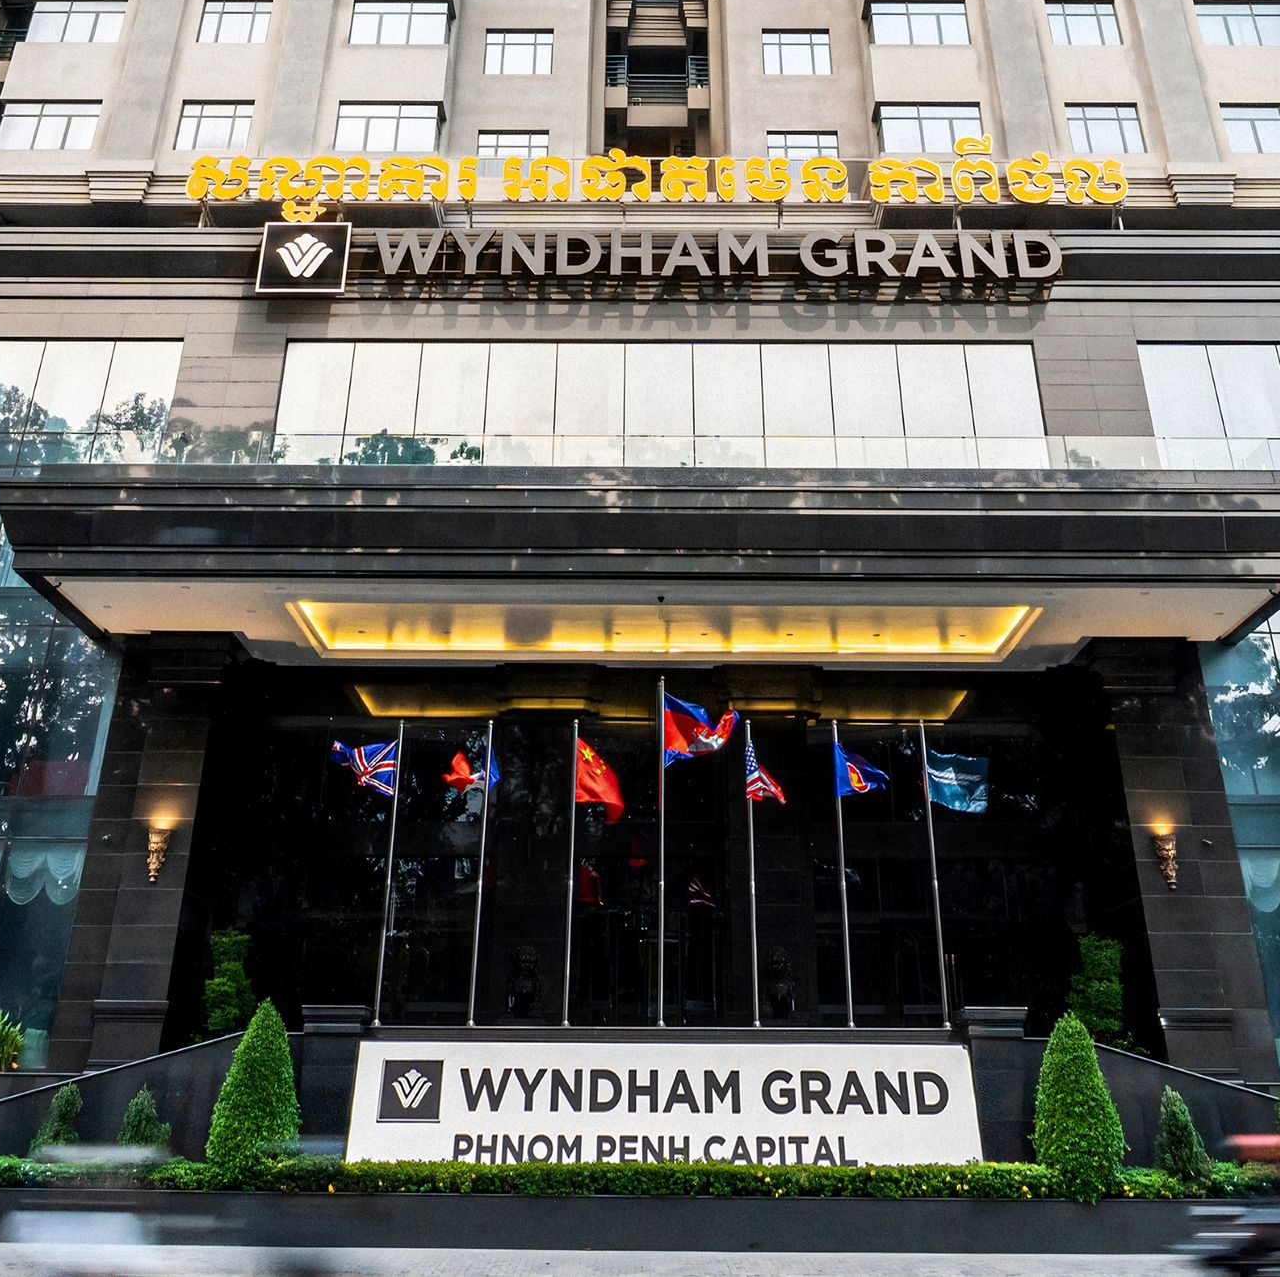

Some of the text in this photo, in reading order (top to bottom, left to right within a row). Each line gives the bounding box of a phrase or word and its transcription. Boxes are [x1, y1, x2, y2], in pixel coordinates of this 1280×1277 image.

[374, 228, 1064, 280] WYNDHAM GRAND
[460, 1067, 950, 1116] WYNDHAM GRAND
[453, 1134, 859, 1167] PHNOM PENH CAPITAL
